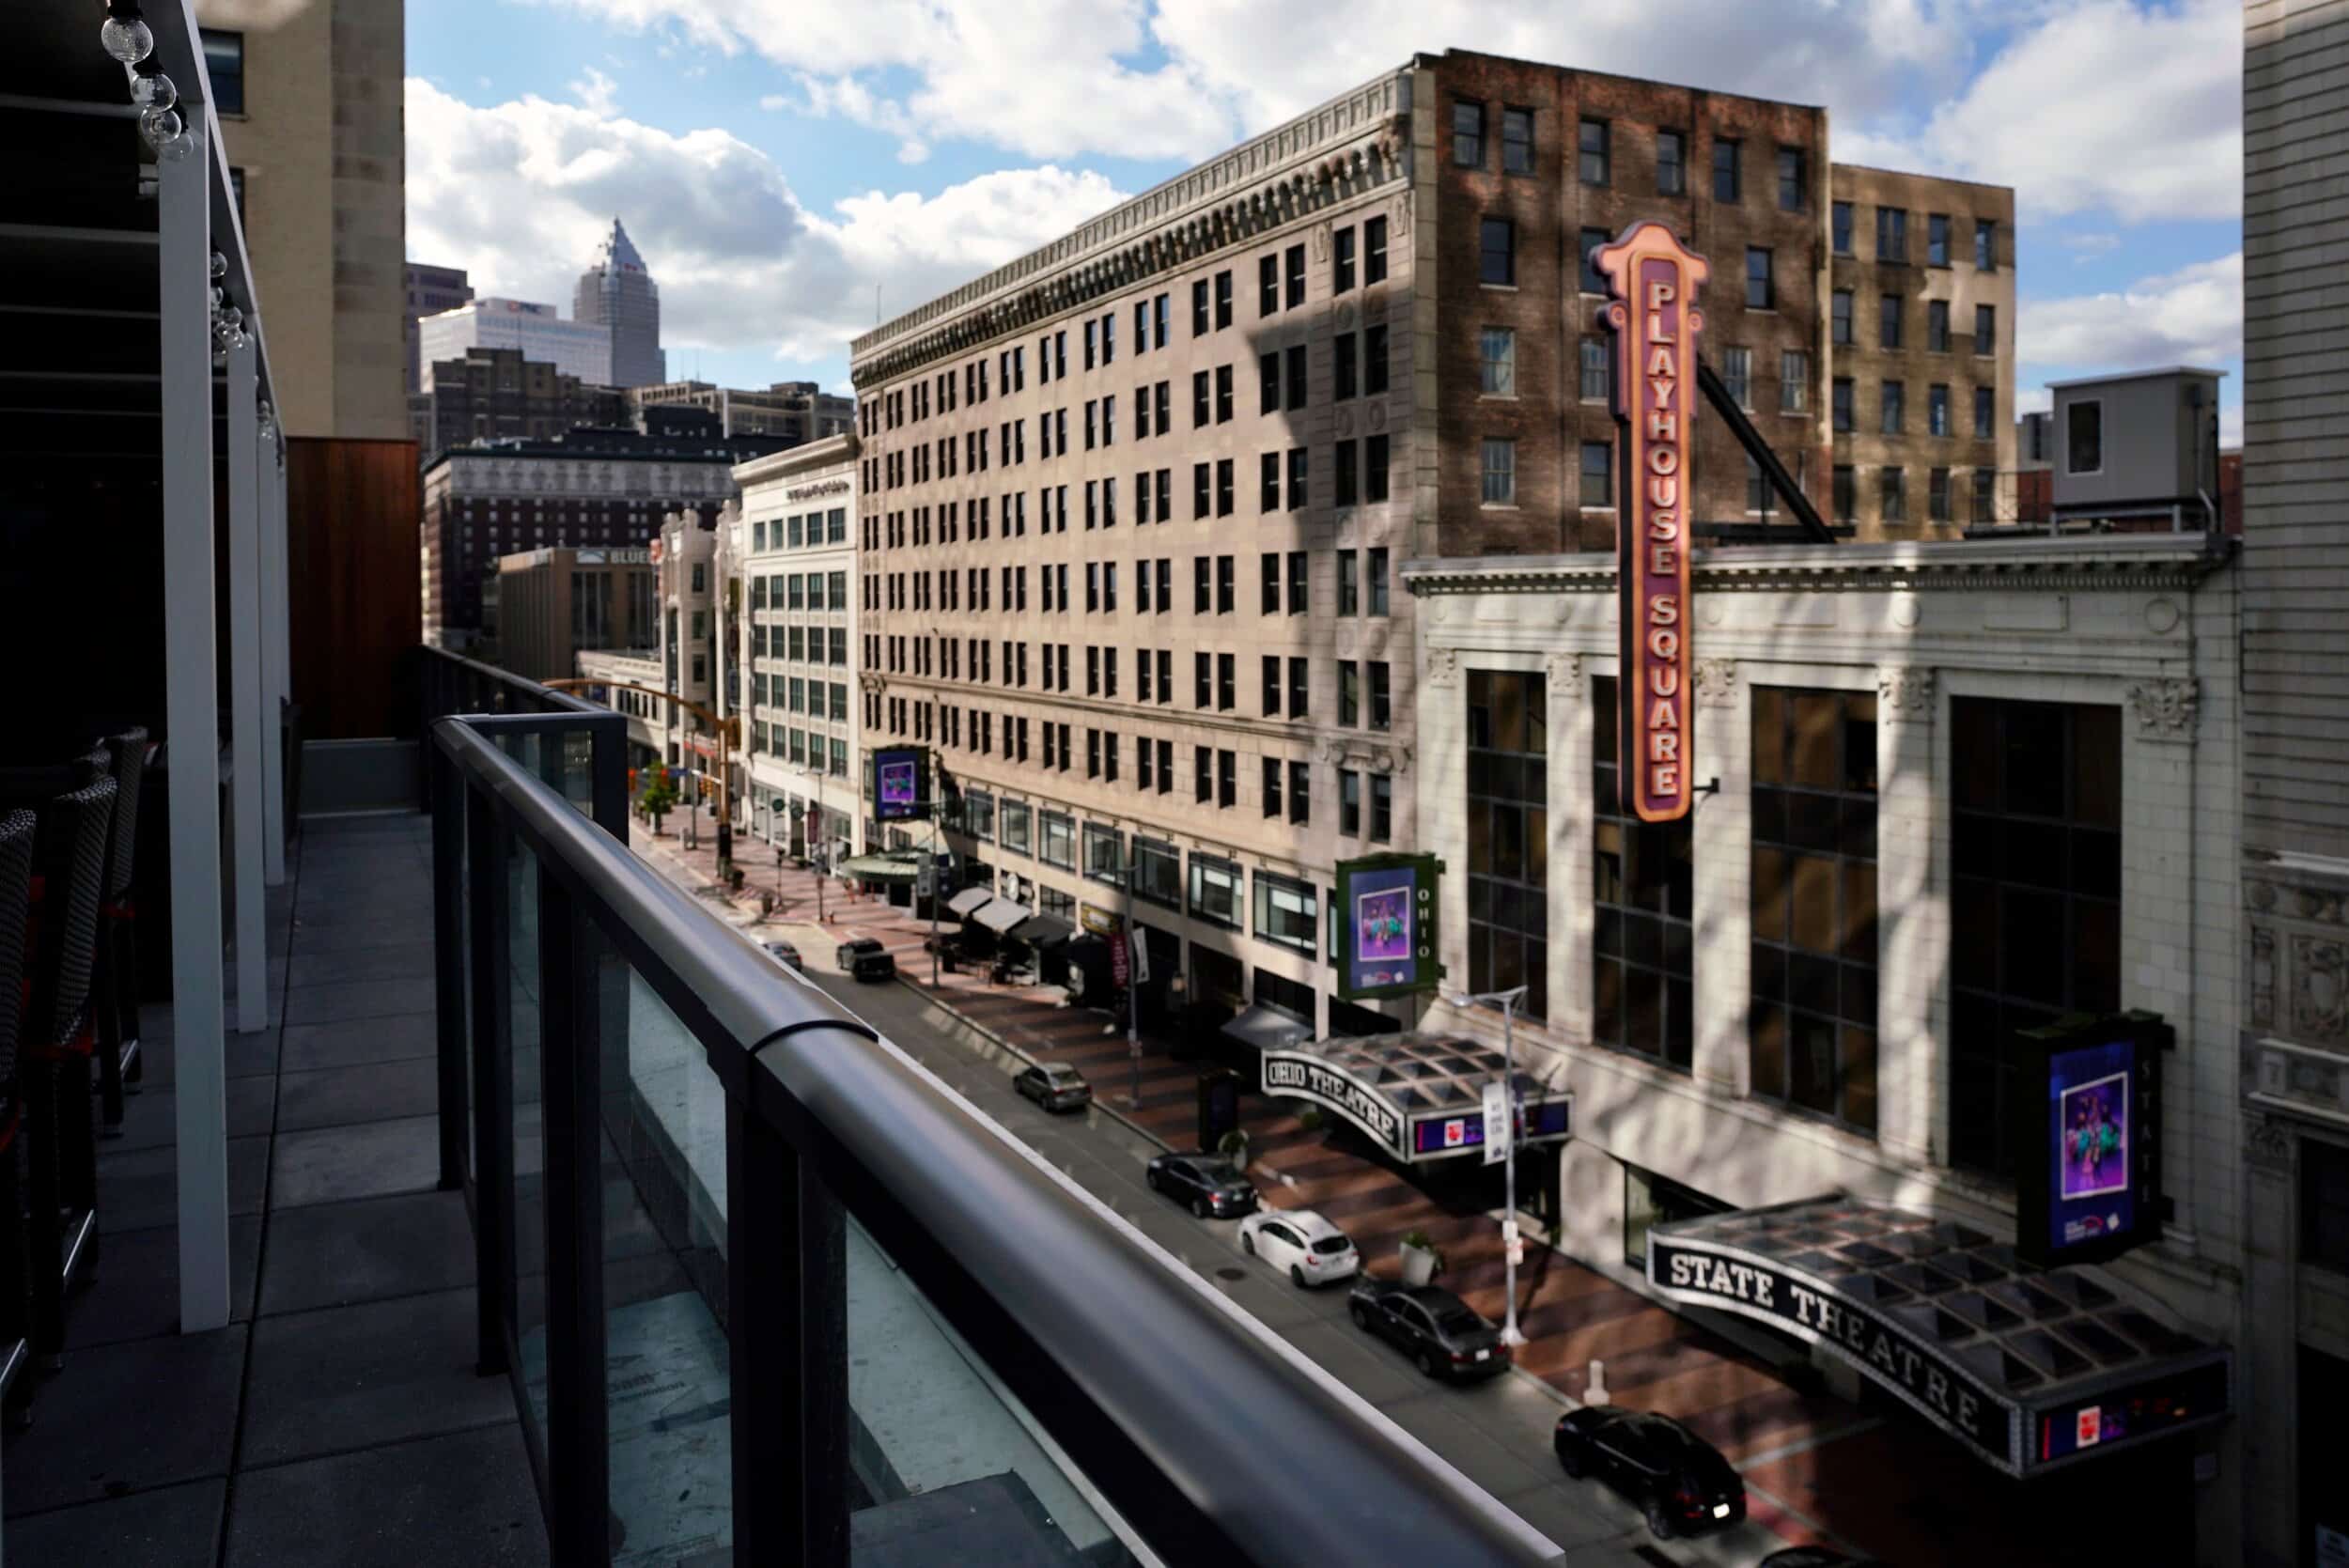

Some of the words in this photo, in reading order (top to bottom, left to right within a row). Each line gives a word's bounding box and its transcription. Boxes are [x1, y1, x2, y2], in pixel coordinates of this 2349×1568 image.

[1649, 282, 1677, 575] PLAYHOUSE
[610, 550, 650, 564] BLUE
[1650, 596, 1679, 797] SQUARE
[1418, 889, 1430, 957] OHIO
[1268, 1061, 1306, 1086] OHIO
[1309, 1066, 1394, 1142] THEATRE
[1671, 1255, 1774, 1307] STATE
[1790, 1286, 1979, 1436] THEATRE
